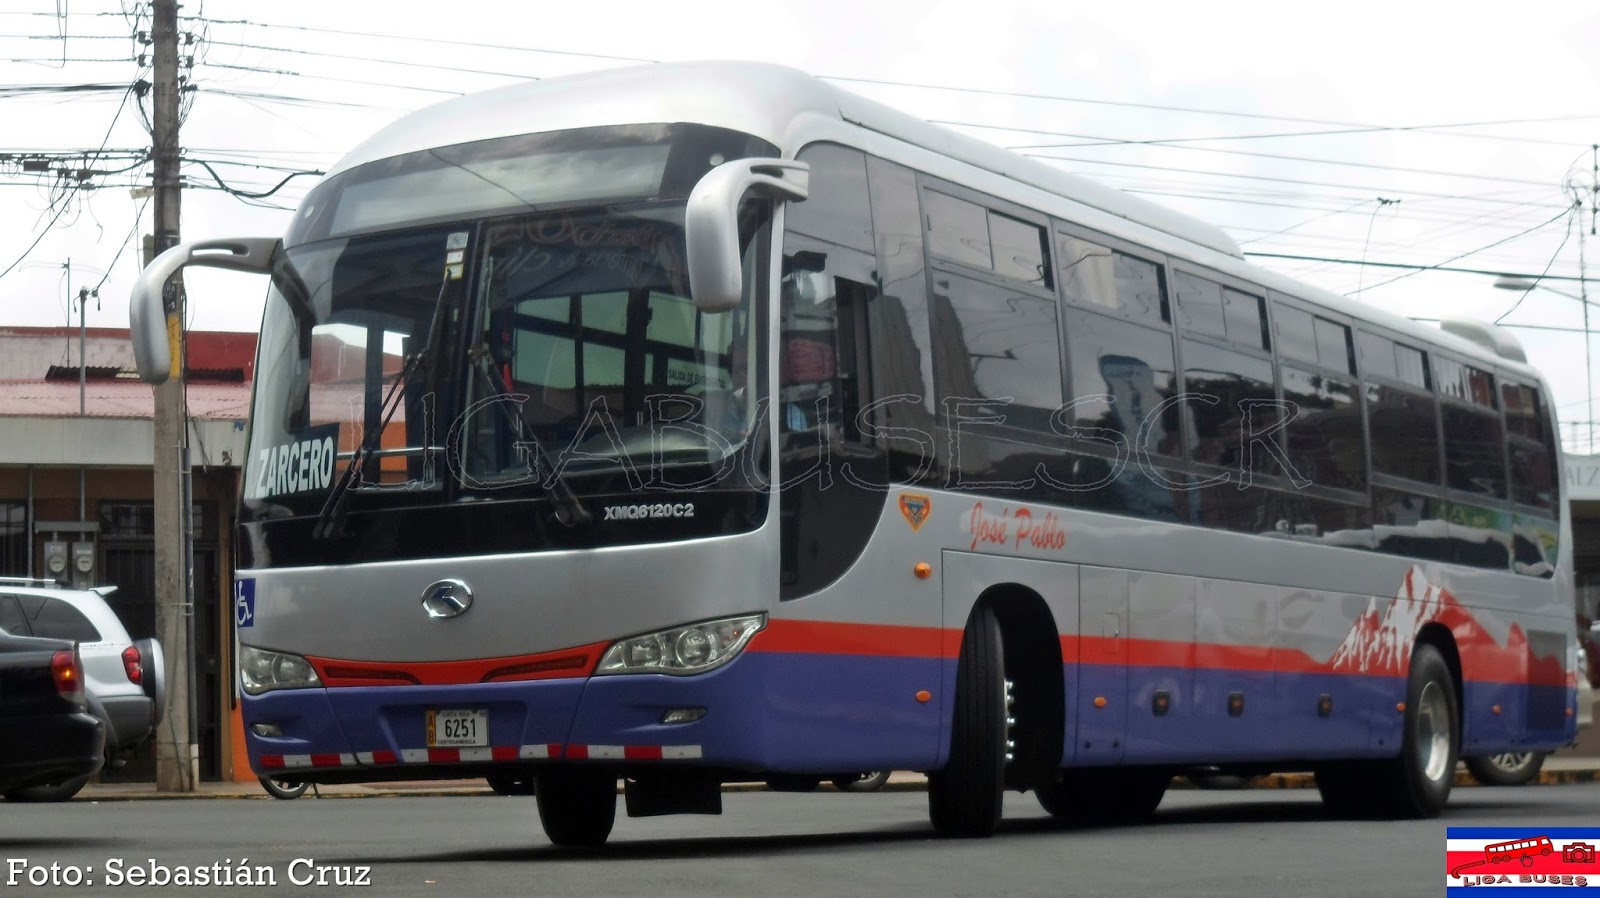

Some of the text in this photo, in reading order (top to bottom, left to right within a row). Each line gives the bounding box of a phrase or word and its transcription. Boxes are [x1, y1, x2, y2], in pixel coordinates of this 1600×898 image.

[256, 436, 334, 498] ZARCERO
[603, 503, 695, 521] XMQ6120C2
[969, 500, 1067, 551] José Pablo
[445, 719, 476, 738] 6251
